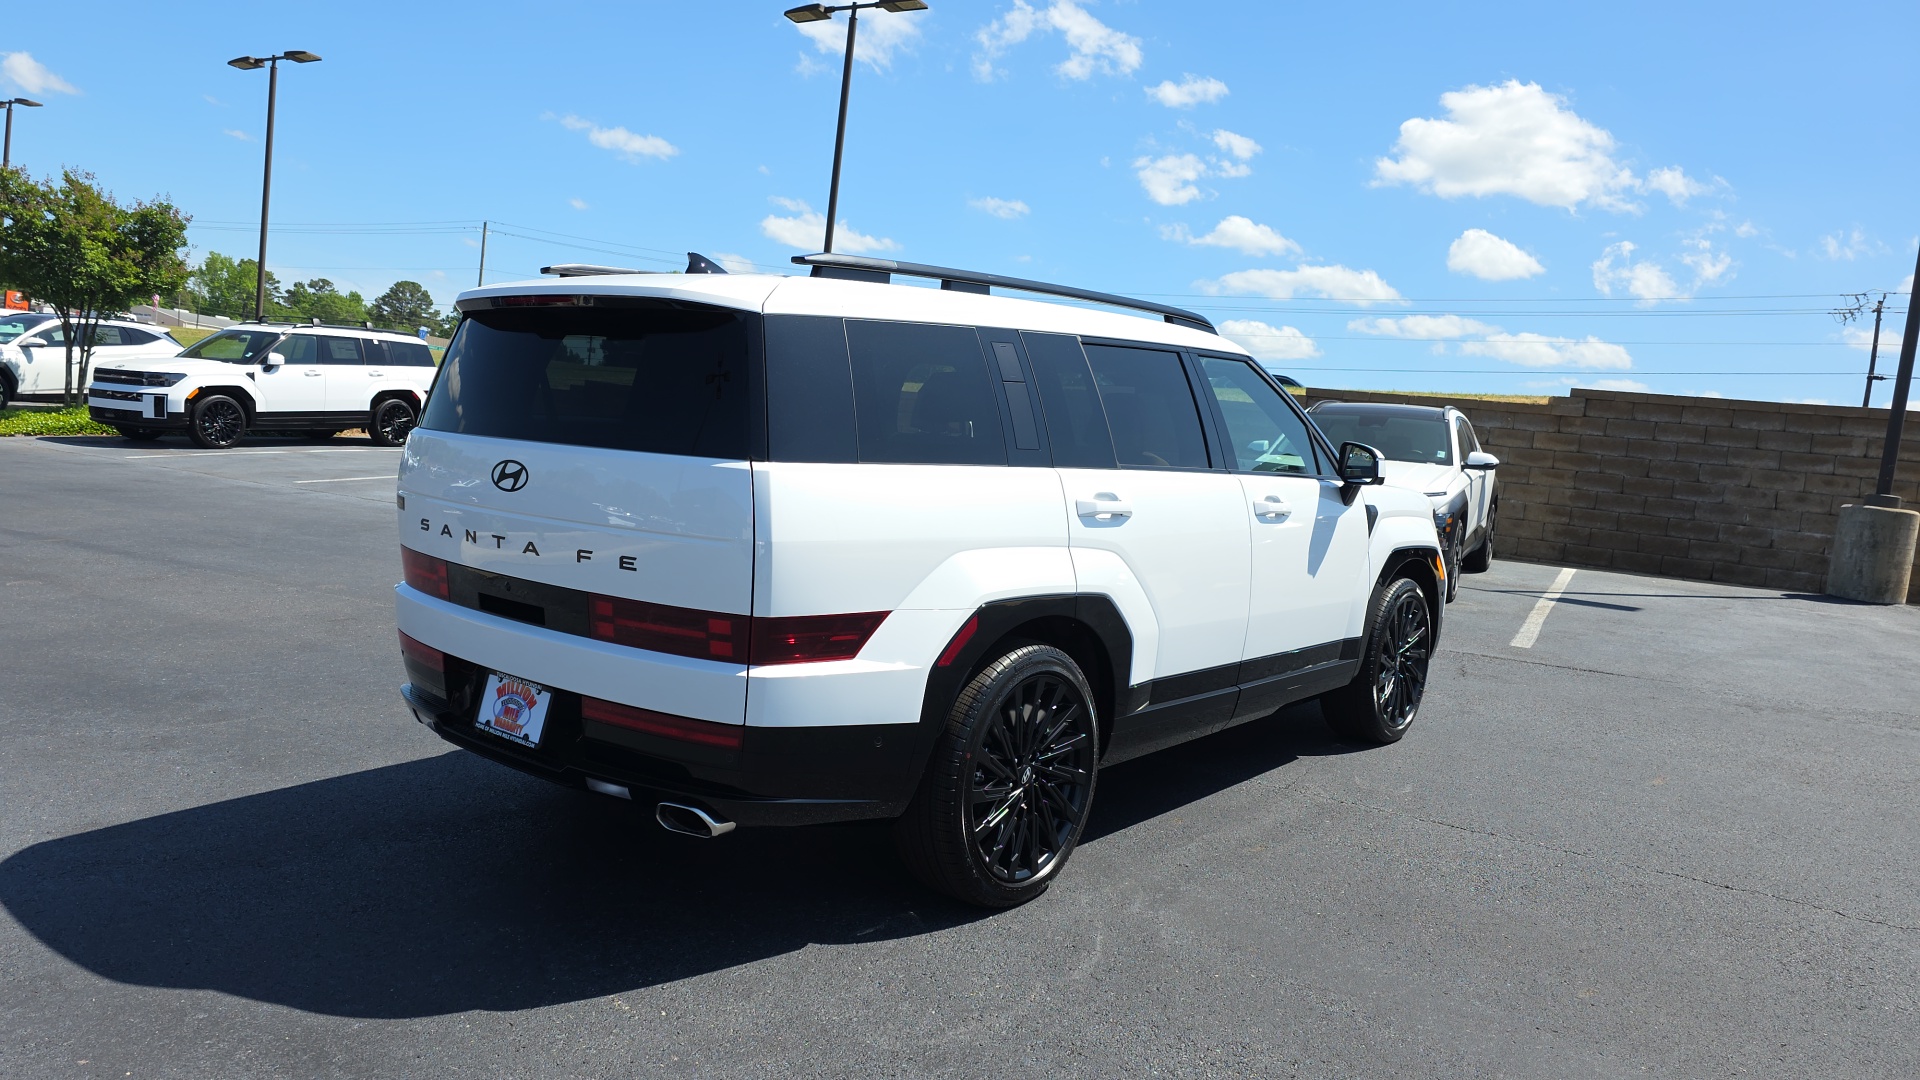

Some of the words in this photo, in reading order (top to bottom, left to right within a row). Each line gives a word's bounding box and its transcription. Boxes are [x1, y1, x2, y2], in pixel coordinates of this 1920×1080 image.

[420, 518, 540, 557] SANTA
[576, 549, 638, 572] FE
[496, 681, 537, 711] MILLION
[522, 681, 543, 690] HYUNDAI
[503, 705, 520, 722] MILE
